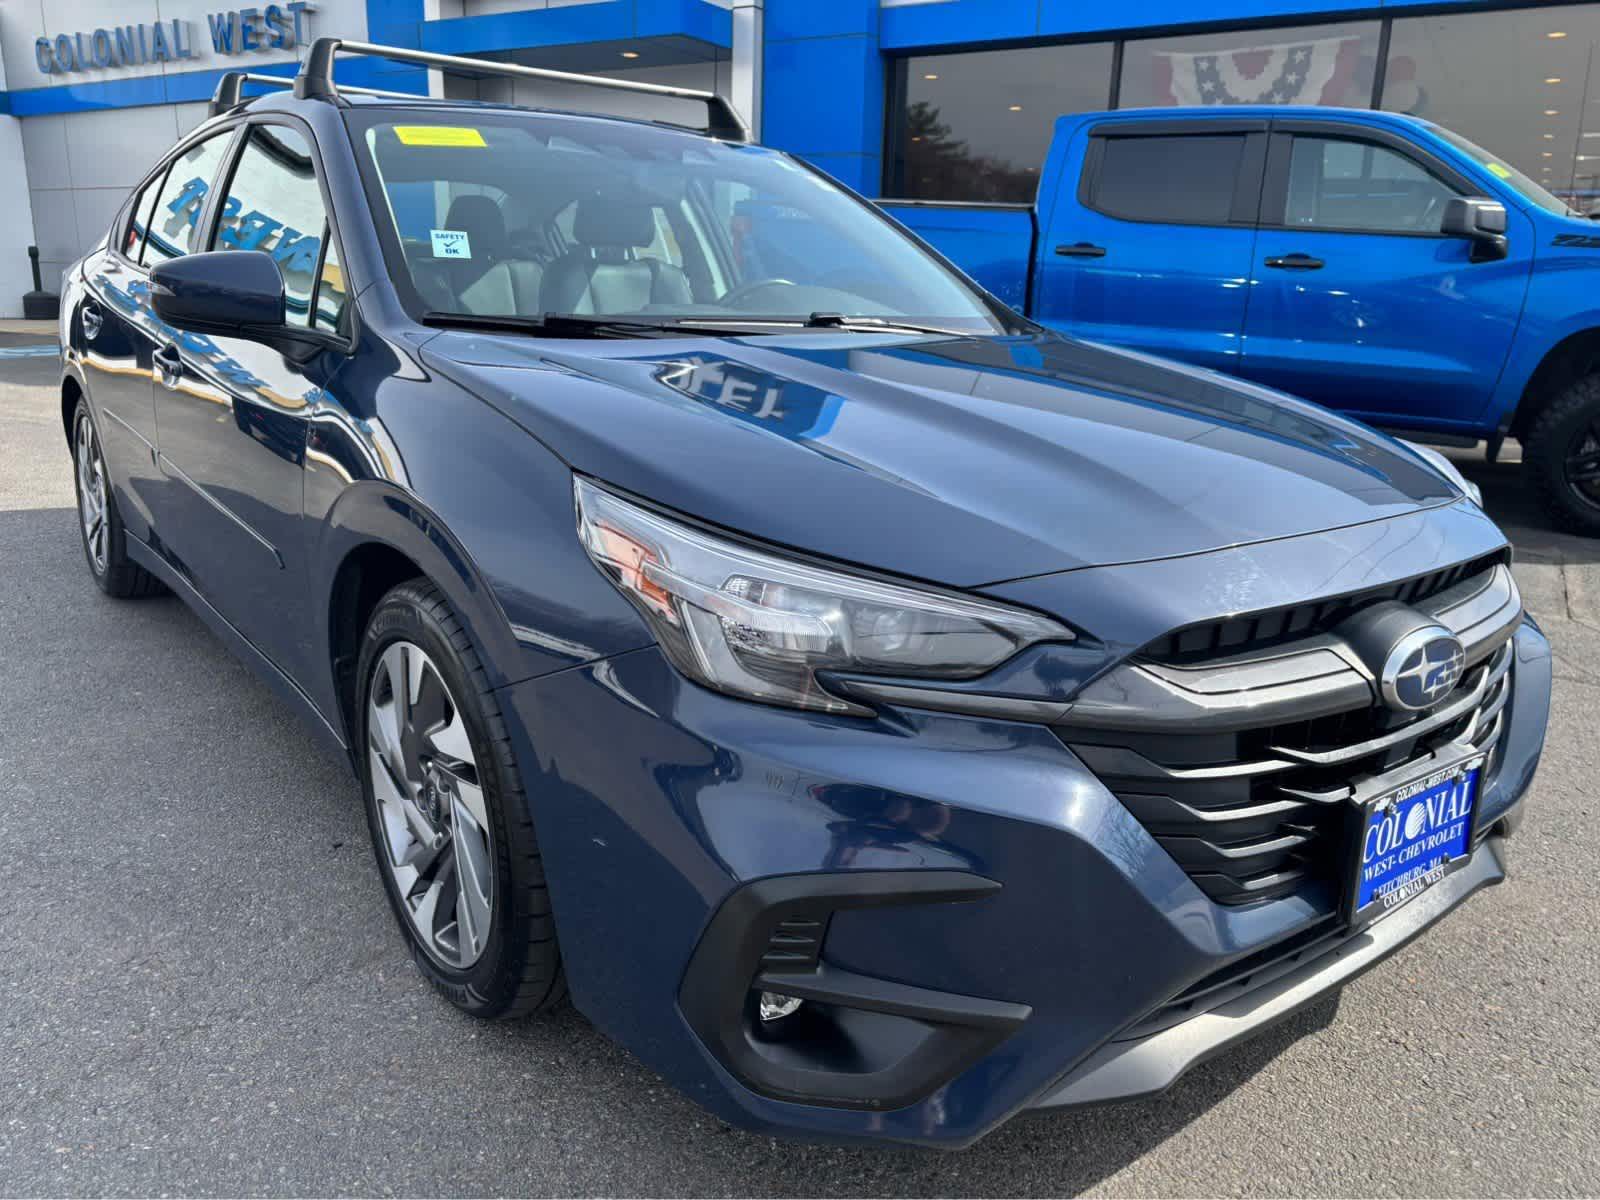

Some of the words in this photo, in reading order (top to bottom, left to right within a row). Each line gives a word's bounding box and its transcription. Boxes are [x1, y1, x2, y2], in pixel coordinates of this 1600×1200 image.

[35, 18, 193, 74] COLONIAL
[207, 2, 308, 56] WEST
[1362, 781, 1472, 863] COLONIAL
[1398, 822, 1464, 864] CHEVROLET
[1383, 876, 1424, 908] COLONIAL
[1424, 865, 1446, 884] WEST
